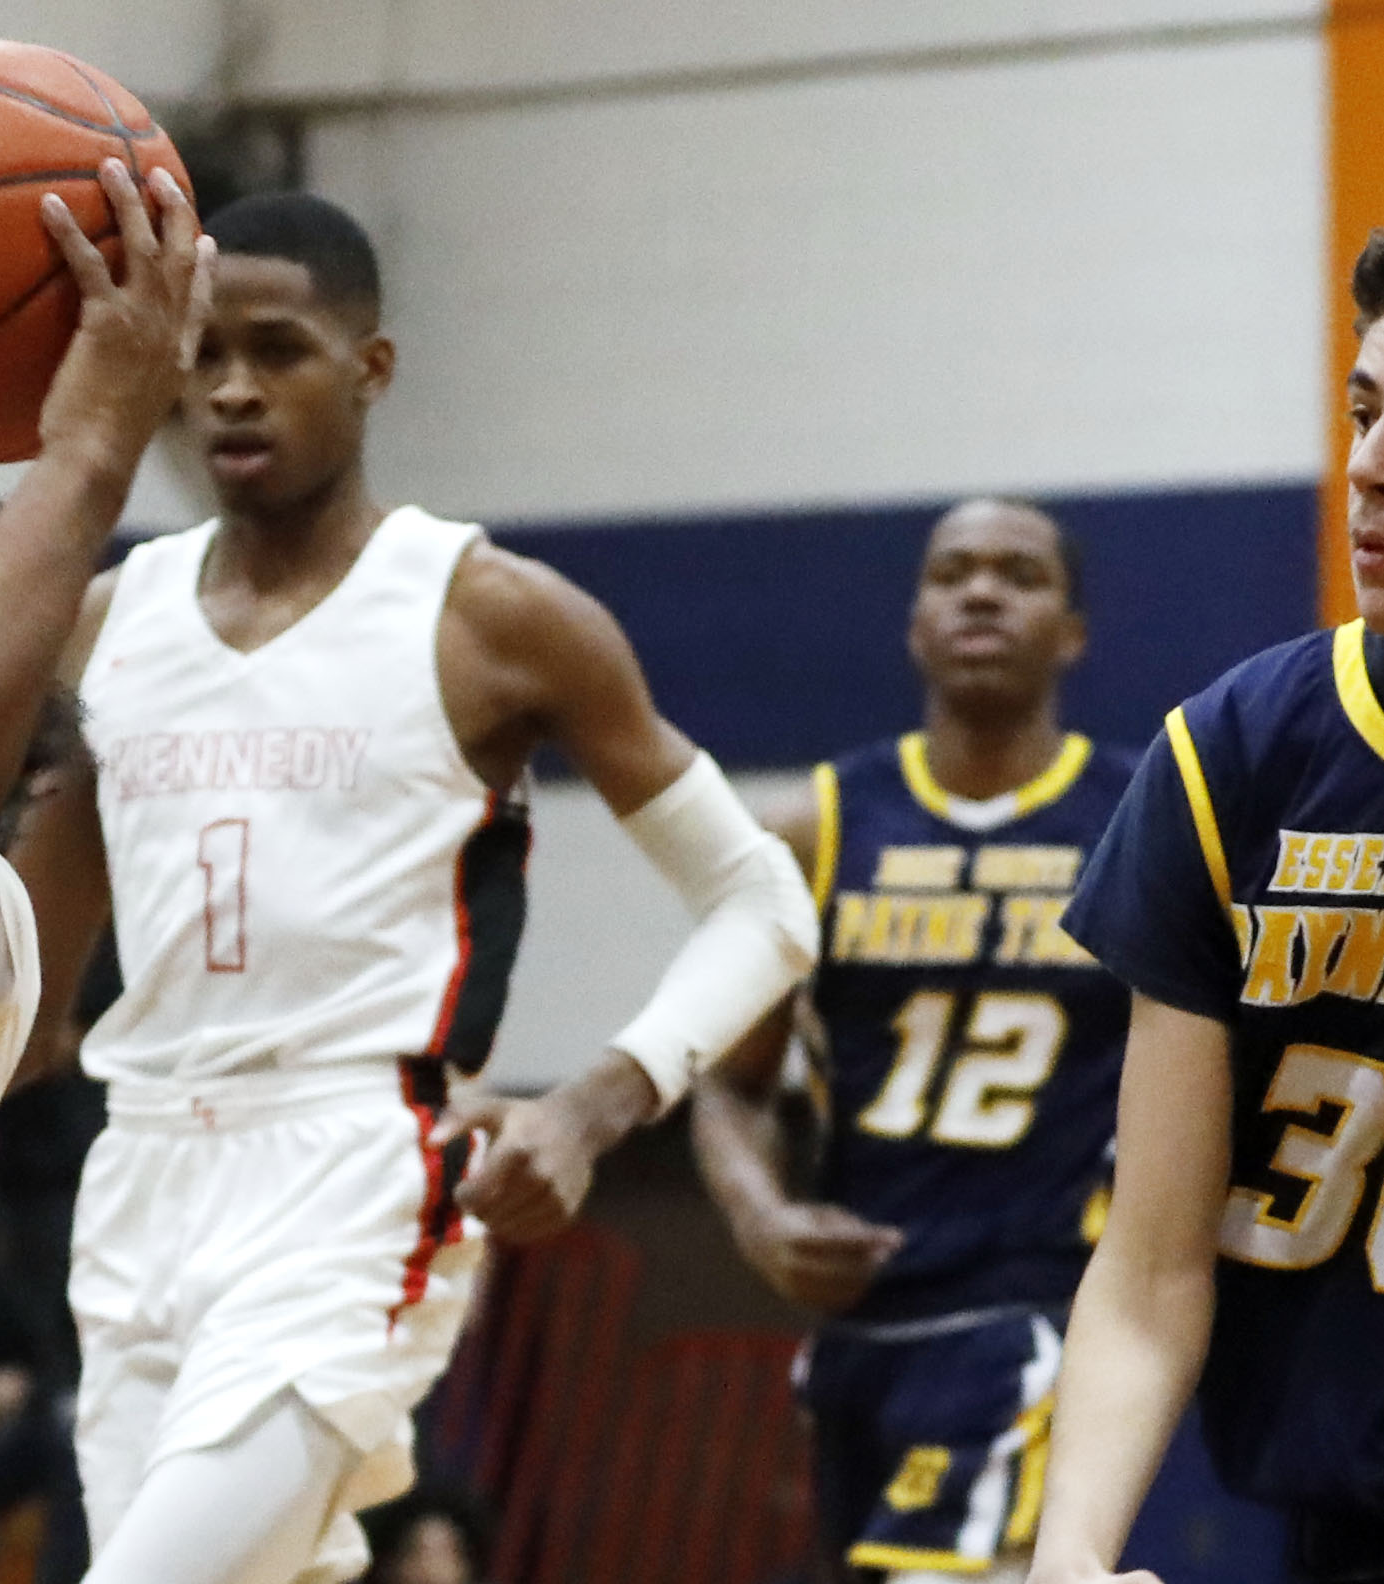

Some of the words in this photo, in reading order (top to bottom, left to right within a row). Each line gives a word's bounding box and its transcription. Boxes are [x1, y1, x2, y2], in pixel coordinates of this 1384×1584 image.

[106, 727, 371, 801] KENNEDY
[197, 817, 250, 973] 1
[1267, 829, 1384, 896] ESSE
[1231, 903, 1384, 1008] AYN
[856, 991, 1068, 1148] 12
